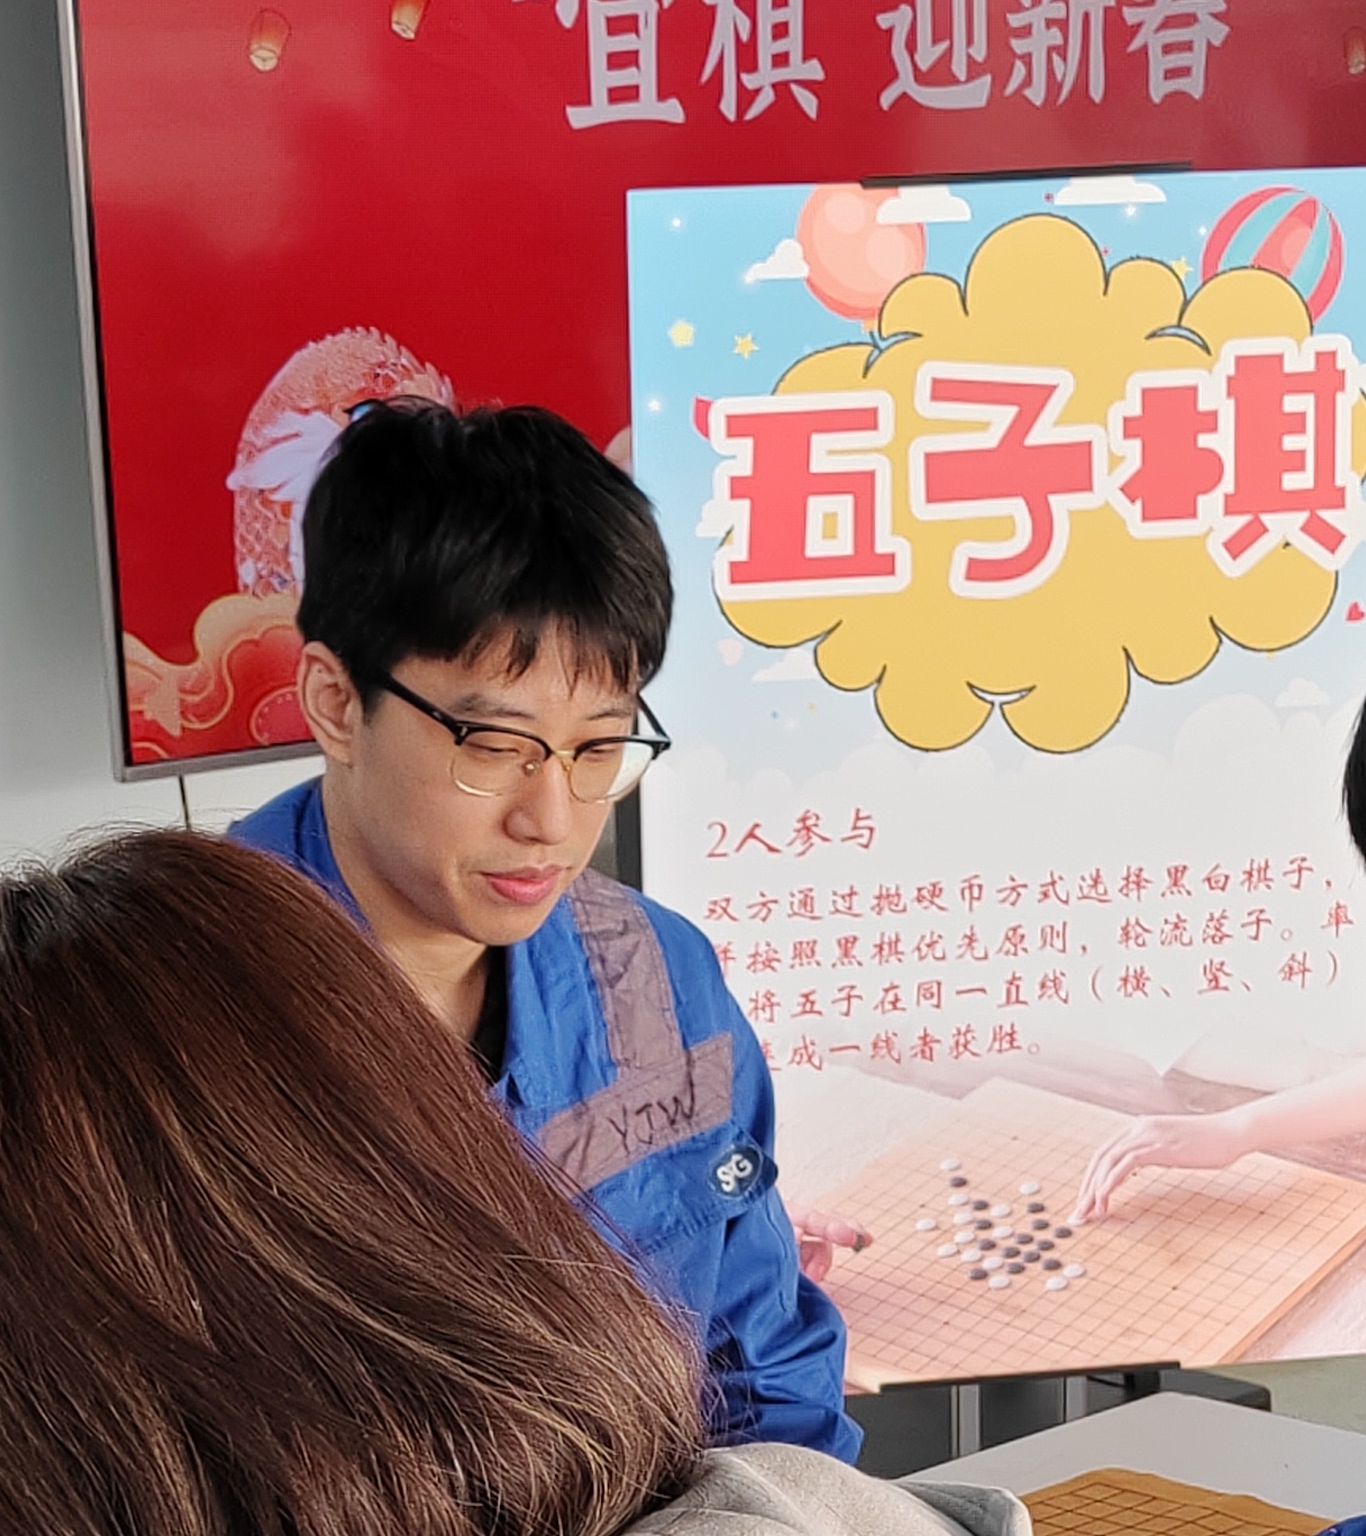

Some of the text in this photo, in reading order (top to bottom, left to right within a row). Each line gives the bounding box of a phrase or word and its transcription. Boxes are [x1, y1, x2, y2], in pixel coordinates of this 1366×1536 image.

[876, 0, 1233, 112] 迎新春
[715, 340, 1353, 594] 五子棋
[705, 807, 877, 859] 2人参与
